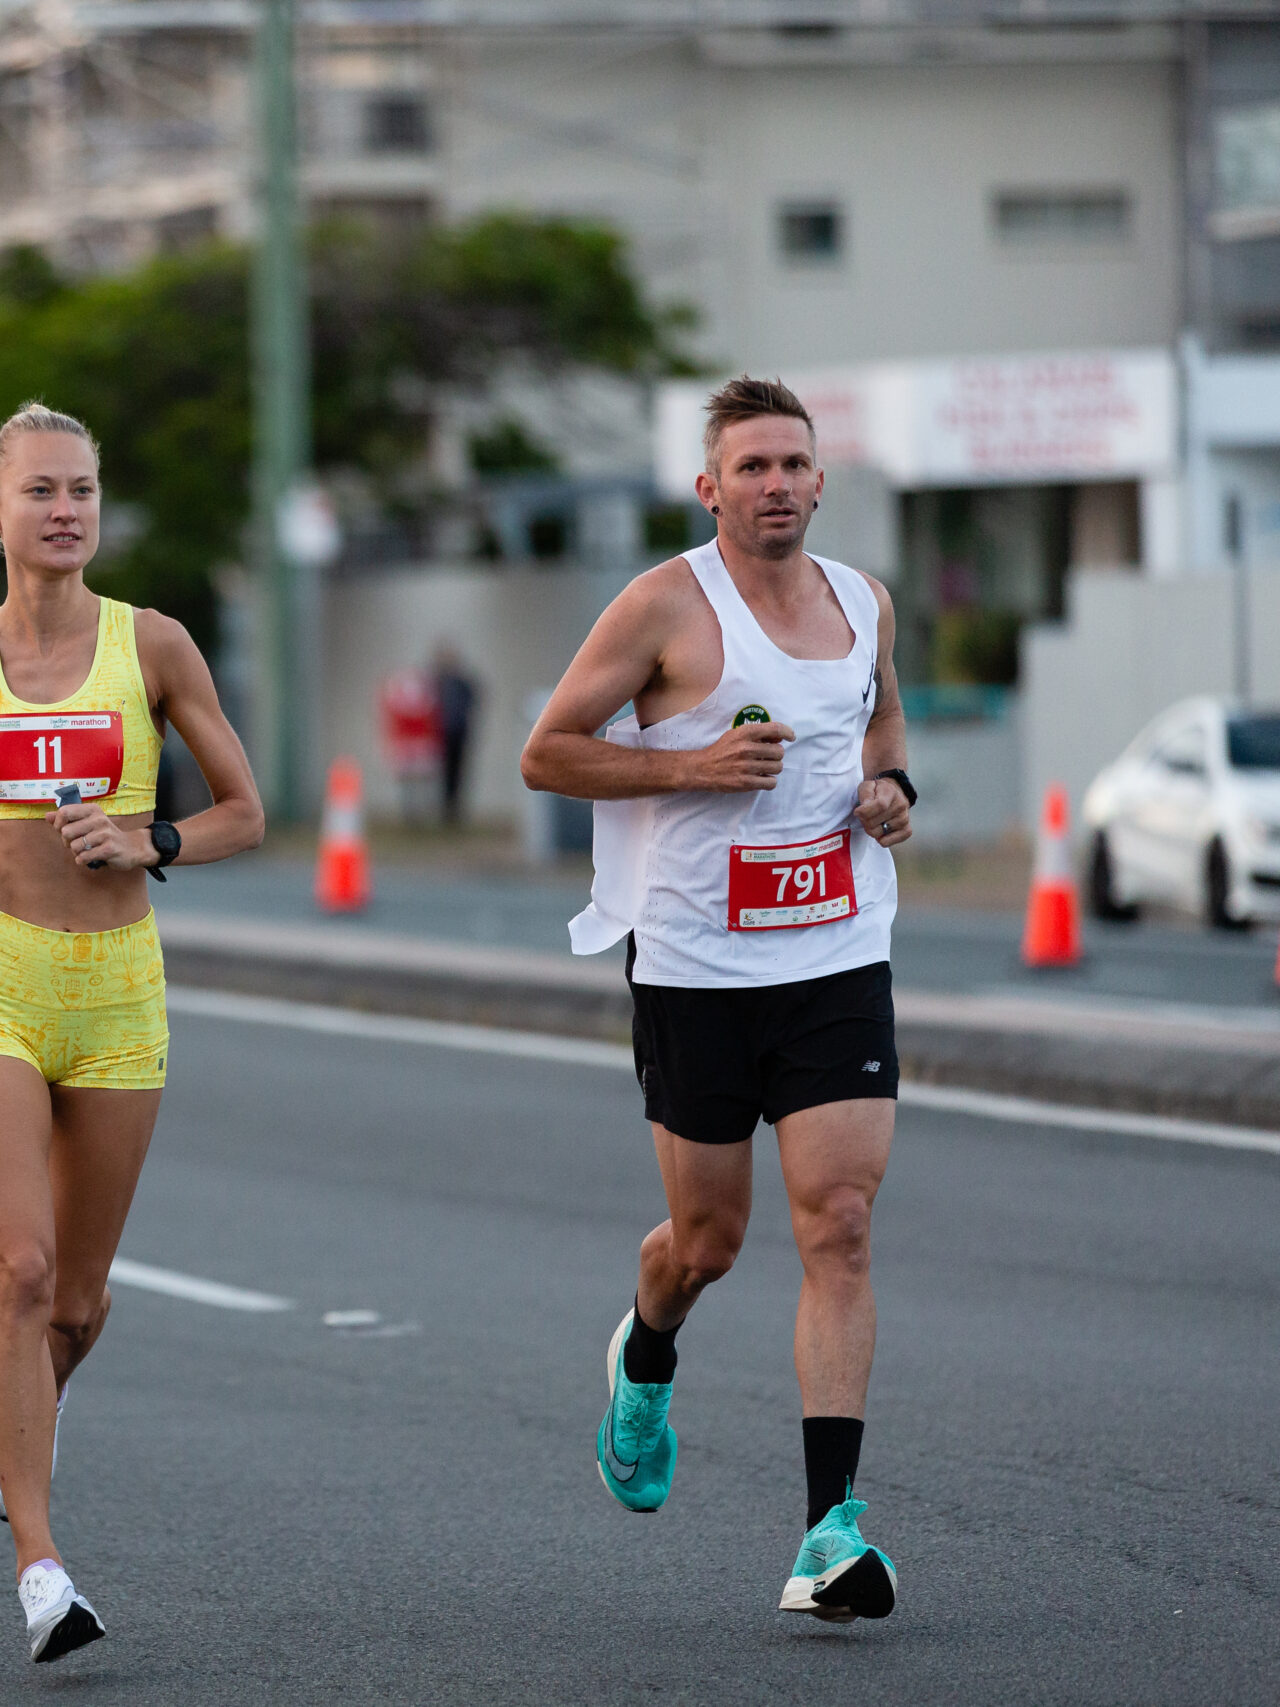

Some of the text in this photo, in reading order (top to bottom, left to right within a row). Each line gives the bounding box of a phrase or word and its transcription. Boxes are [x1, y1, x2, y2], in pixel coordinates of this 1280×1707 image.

[33, 736, 62, 773] 11
[818, 840, 841, 852] marathon
[772, 861, 826, 902] 791
